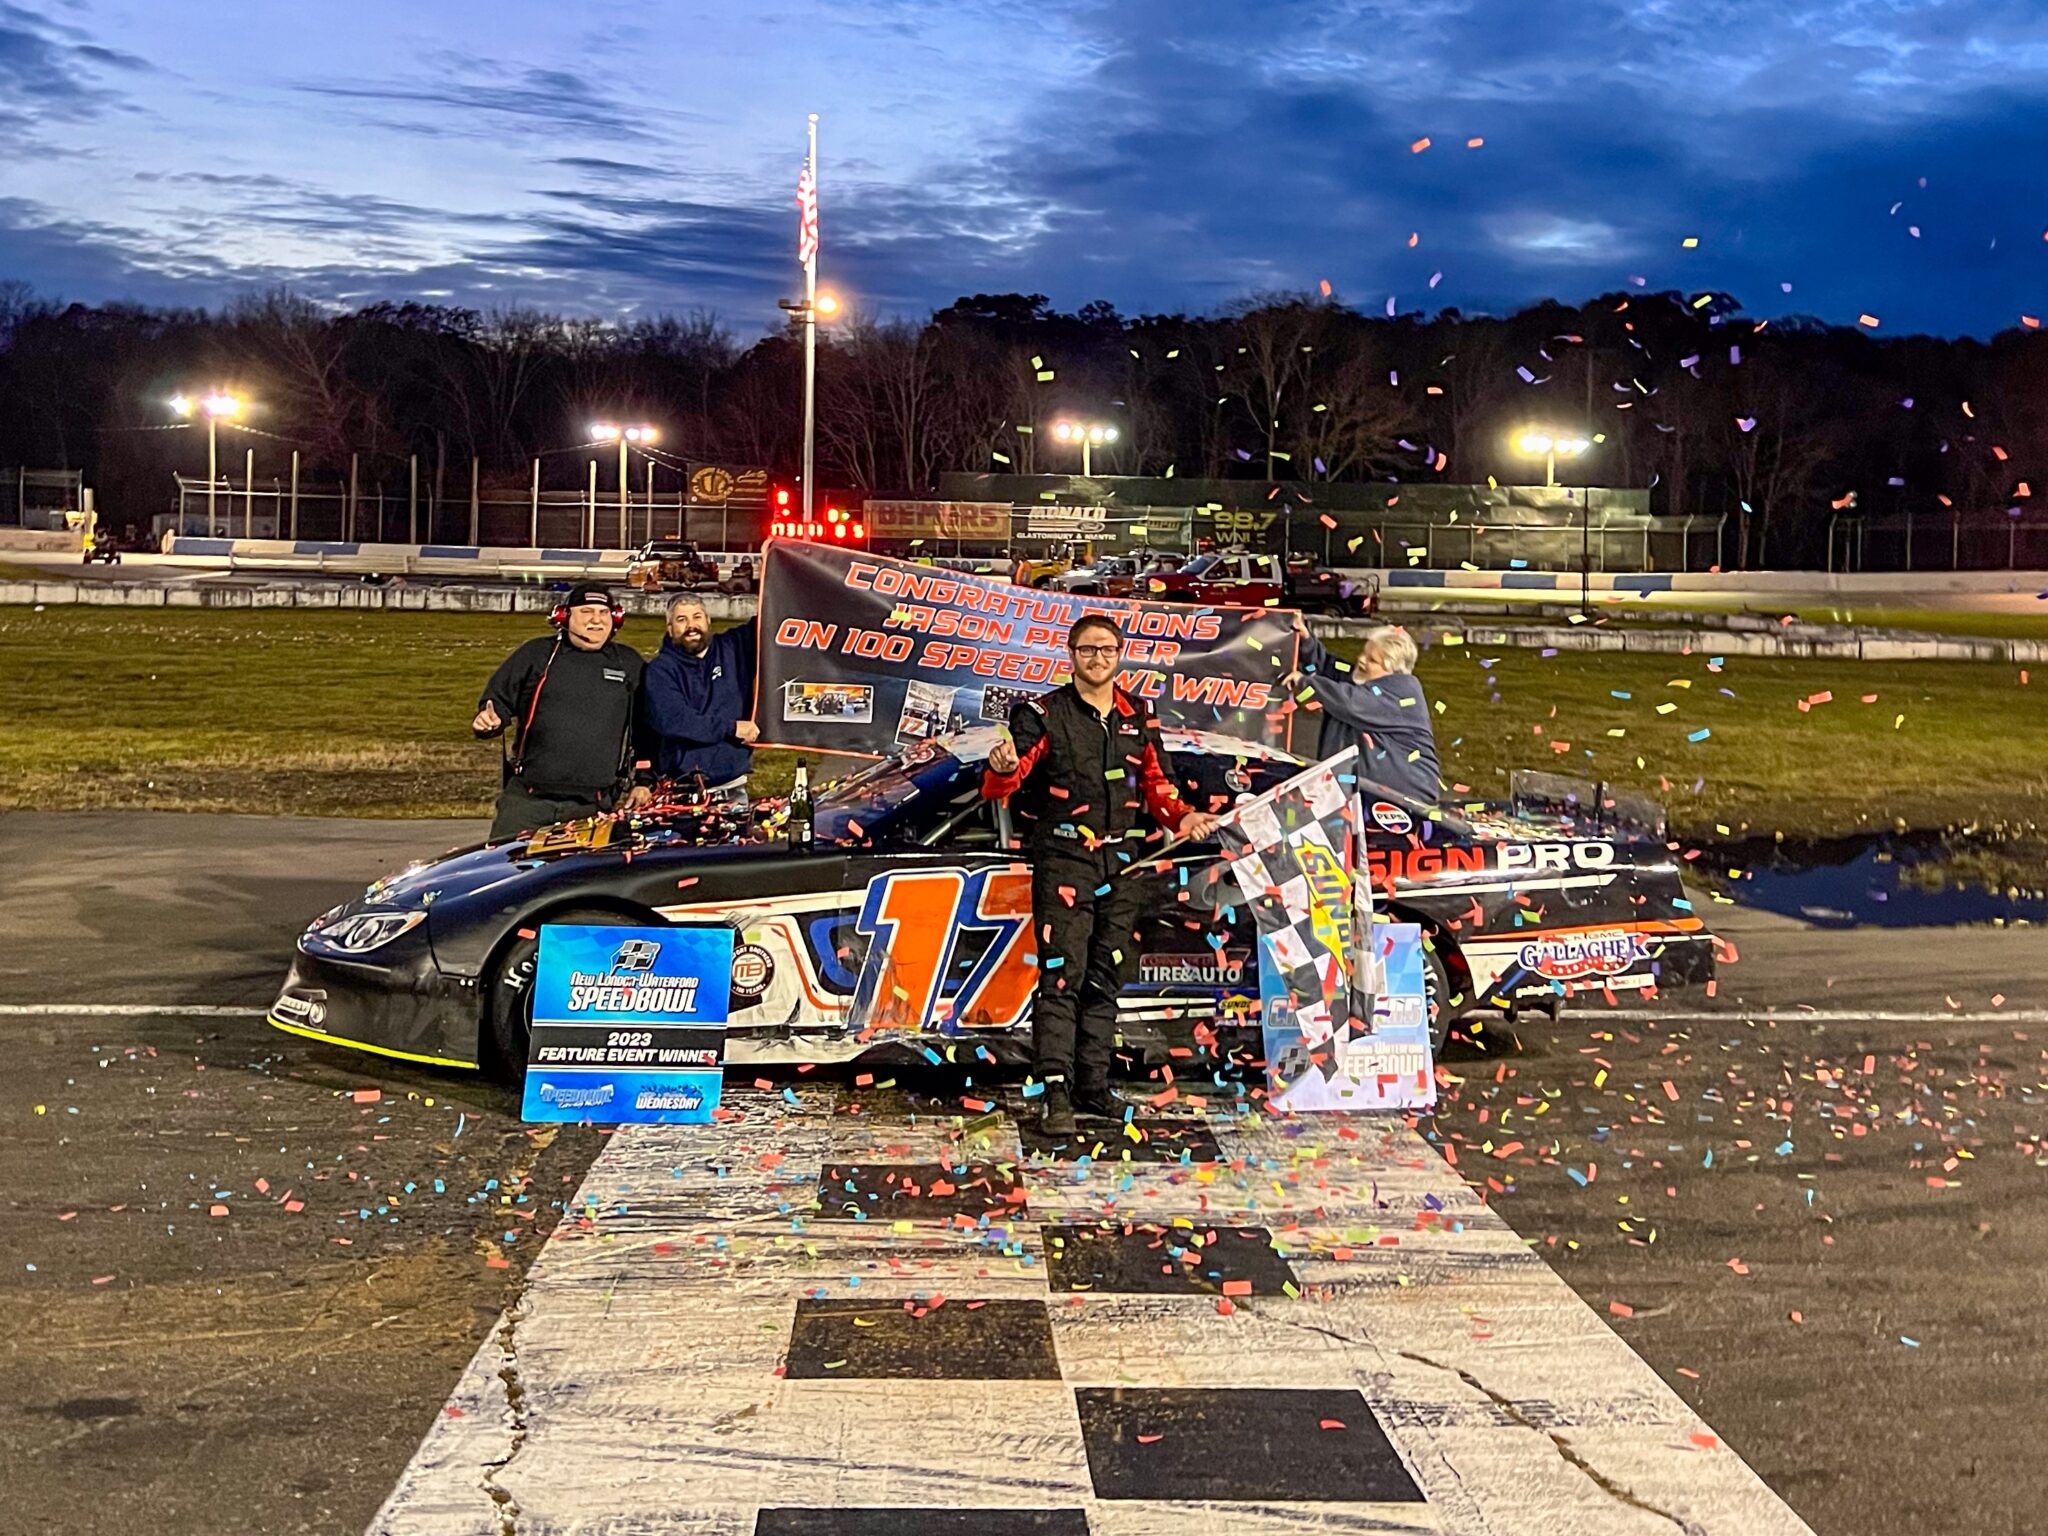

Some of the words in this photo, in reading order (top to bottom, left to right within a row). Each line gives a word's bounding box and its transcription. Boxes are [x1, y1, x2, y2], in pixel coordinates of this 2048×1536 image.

[844, 562, 1222, 641] CONGRATULTIONS
[883, 602, 1014, 645] JASON
[1022, 626, 1181, 667] PAER
[775, 618, 838, 650] ON
[841, 628, 915, 663] 100
[1172, 673, 1273, 710] WINS
[1376, 811, 1408, 823] PEPSI
[1497, 842, 1615, 874] PRO
[853, 866, 1039, 1034] 17
[1519, 935, 1648, 967] GALLAGHER
[567, 985, 698, 1013] SPEEDBOWL
[537, 1047, 608, 1062] FEATURE
[607, 1048, 659, 1062] EVENT
[658, 1049, 718, 1064] WINNER
[606, 1032, 653, 1047] 2023
[635, 1094, 702, 1110] WEDNESDAY
